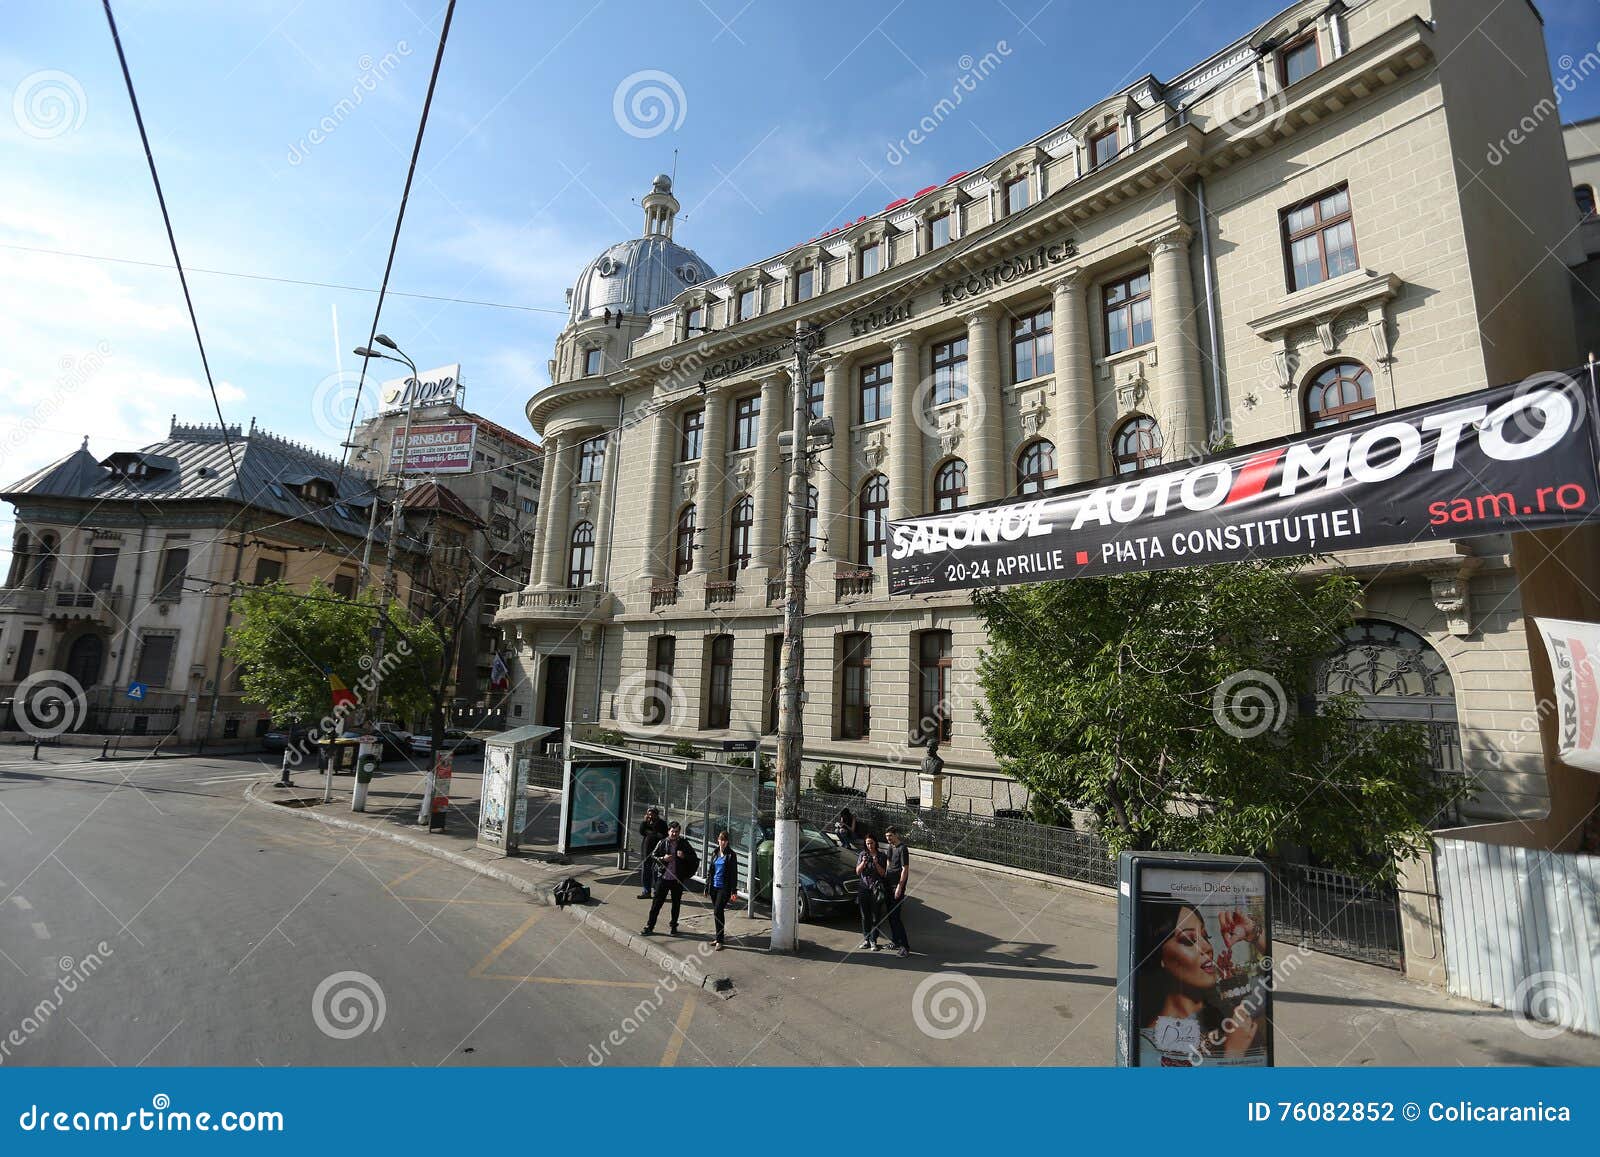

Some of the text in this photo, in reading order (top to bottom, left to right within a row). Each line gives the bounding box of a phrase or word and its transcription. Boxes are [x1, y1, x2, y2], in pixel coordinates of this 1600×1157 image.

[850, 301, 912, 336] STUDII
[940, 239, 1077, 306] ECONOMICE
[399, 376, 454, 406] Dove
[891, 389, 1573, 560] SALONUL AUTO MOTO
[1428, 482, 1587, 526] sam.ro
[948, 560, 990, 582] 20-24
[996, 550, 1065, 577] APRILIE
[1103, 537, 1165, 566] PIAȚA
[1171, 508, 1361, 556] CONSTITUȚIEI
[1204, 882, 1231, 893] Dulce
